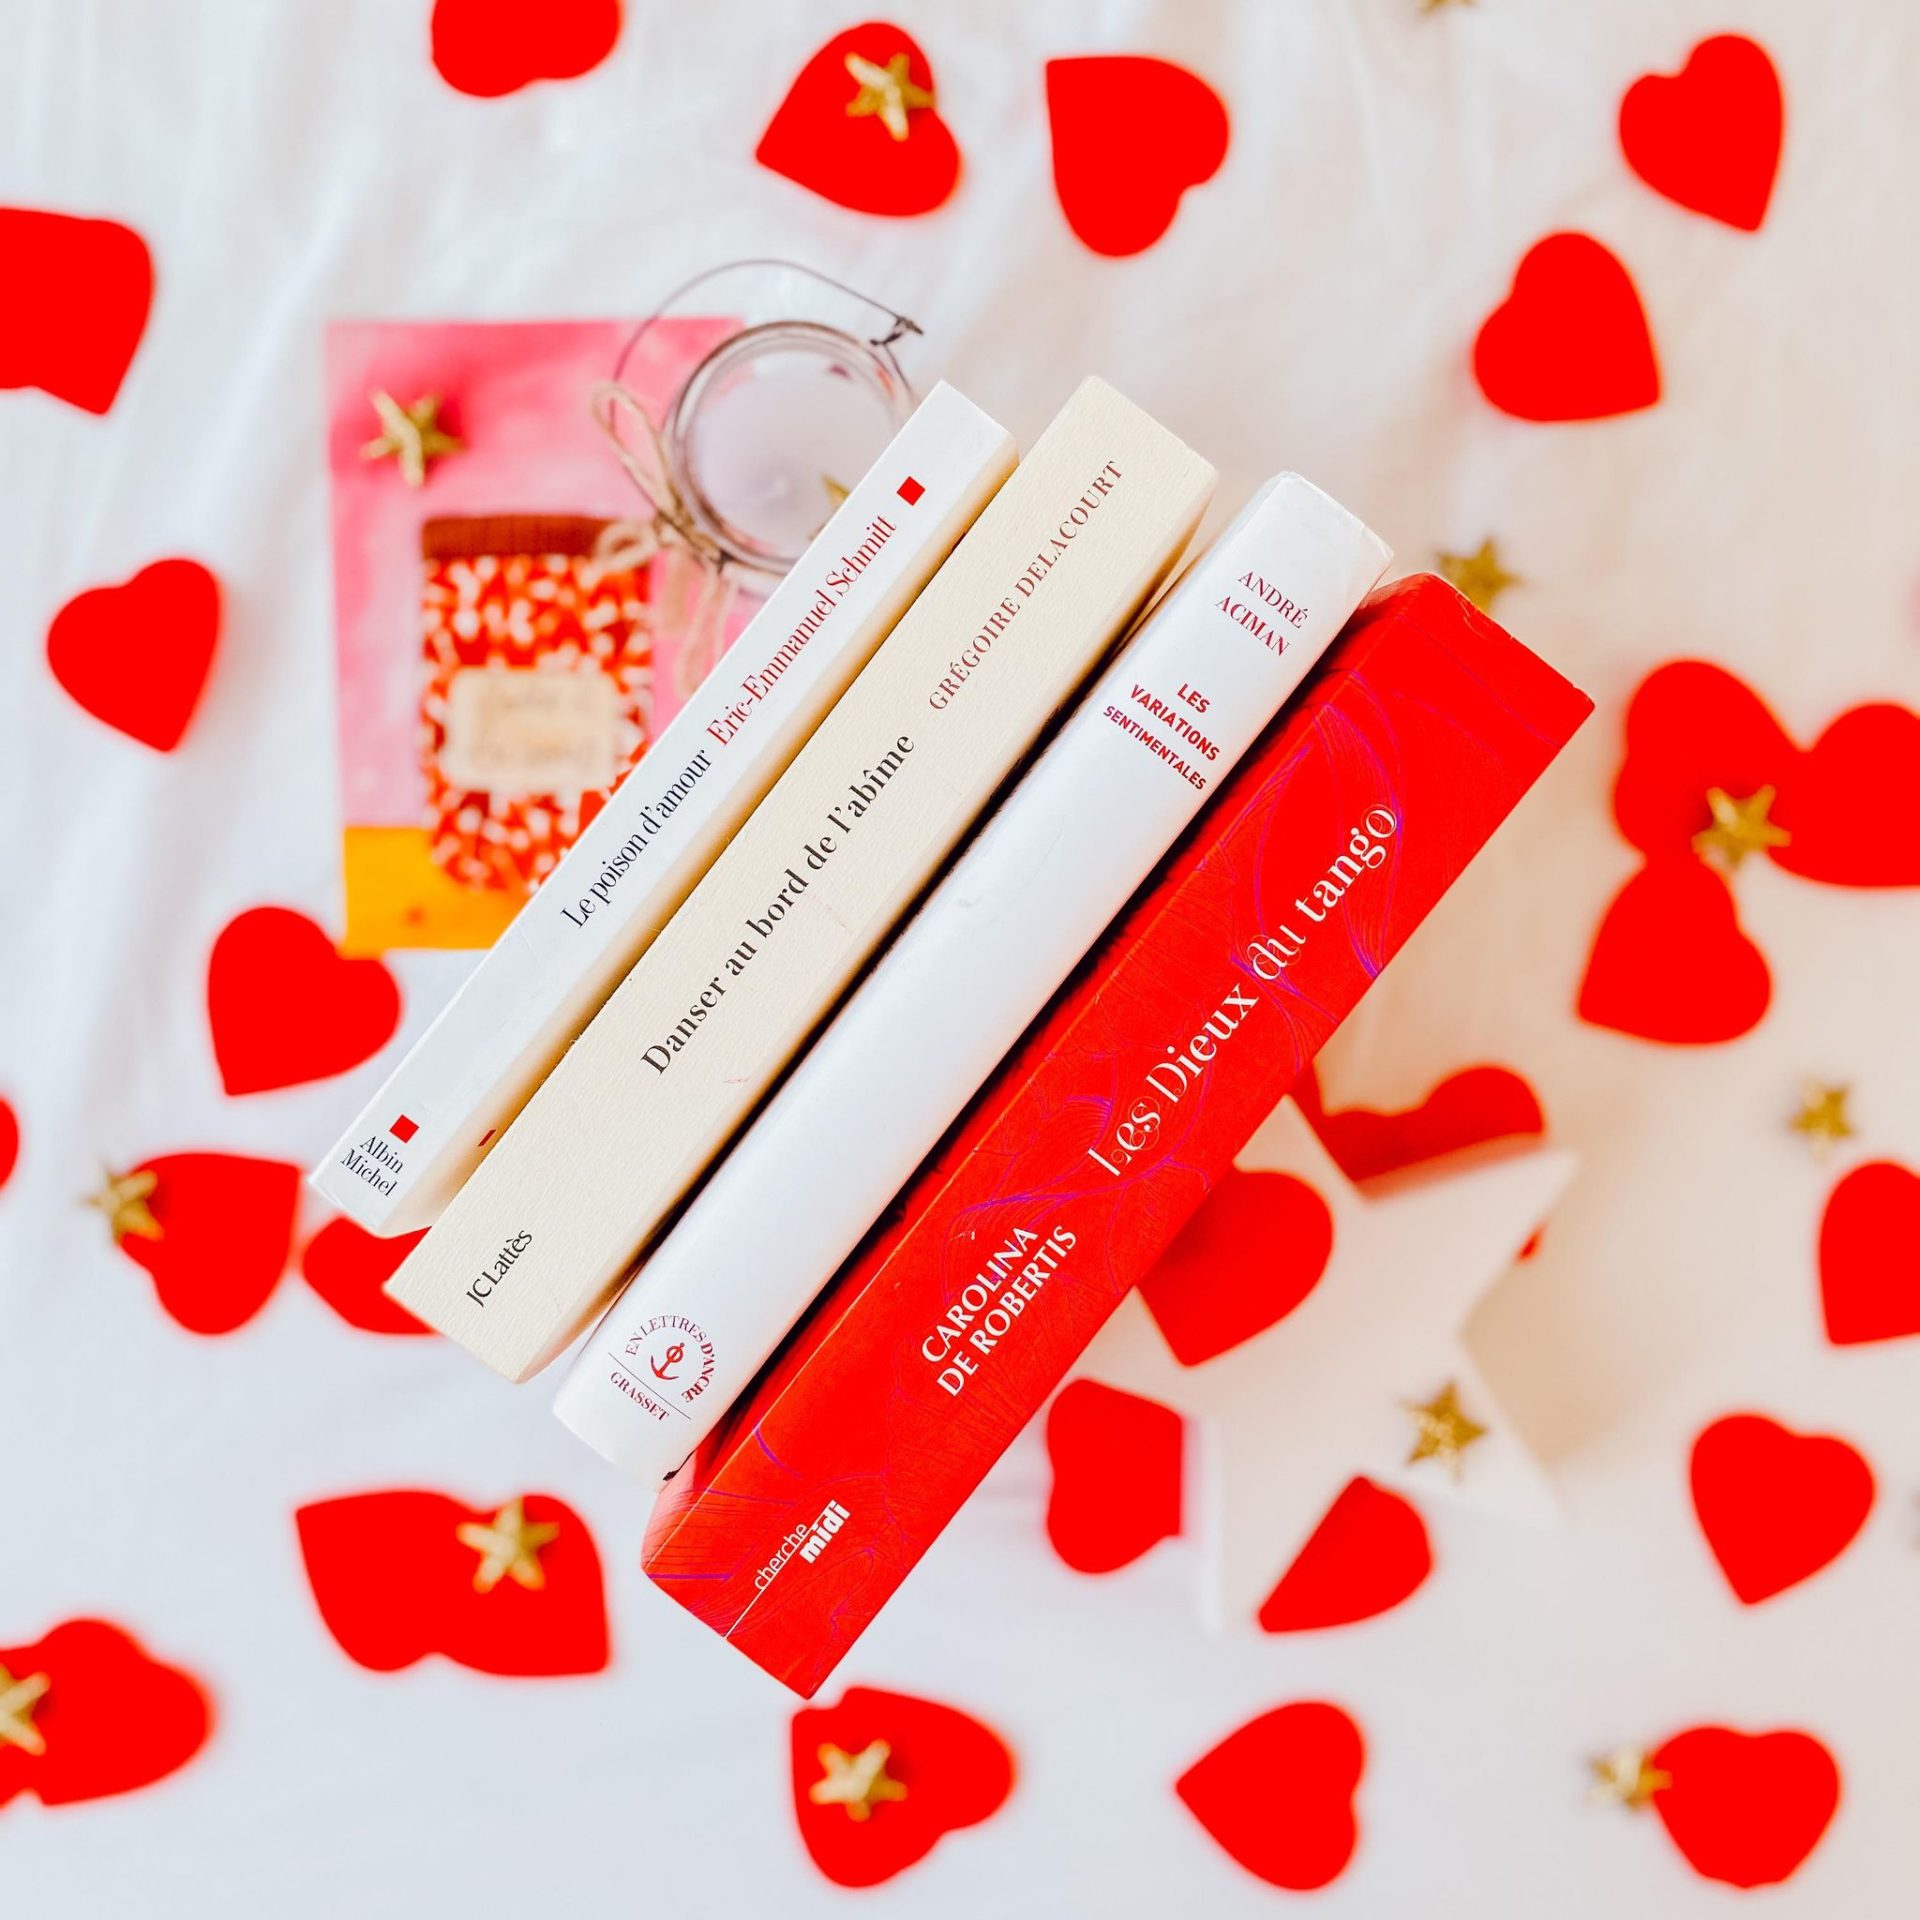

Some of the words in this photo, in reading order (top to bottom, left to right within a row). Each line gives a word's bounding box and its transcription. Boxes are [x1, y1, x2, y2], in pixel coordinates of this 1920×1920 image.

[929, 597, 1022, 712] GRÉGOIRE
[1015, 460, 1124, 598] DELACOURT
[1215, 595, 1291, 657] ACIMAN
[1238, 570, 1310, 629] ANDRÉ
[706, 591, 839, 748] Eric-Emmanuel
[826, 515, 897, 597] Schmitt
[1130, 683, 1220, 762] VARIATIONS
[1177, 681, 1211, 714] LES
[1103, 705, 1207, 790] SENTIMENTALES
[560, 896, 596, 930] Le
[589, 830, 650, 907] poison
[639, 749, 713, 836] d'amour
[641, 976, 728, 1074] Danser
[725, 941, 758, 977] au
[746, 868, 809, 939] bord
[804, 834, 838, 870] de
[827, 734, 916, 834] l'abîme
[1087, 1094, 1163, 1177] Les
[1145, 982, 1258, 1103] Dieux
[1246, 924, 1307, 981] du
[1294, 803, 1397, 923] tango
[341, 1149, 398, 1197] Michel
[359, 1135, 404, 1174] Albin
[920, 1226, 1040, 1363] CAROLINA
[936, 1351, 979, 1397] DE
[969, 1225, 1078, 1355] ROBERTIS
[609, 1372, 670, 1422] GRASSET
[624, 1332, 643, 1357] EN
[639, 1314, 706, 1344] LETTRES
[681, 1340, 716, 1404] D'ANCRE
[754, 1524, 808, 1591] cherche
[800, 1500, 851, 1564] midi
